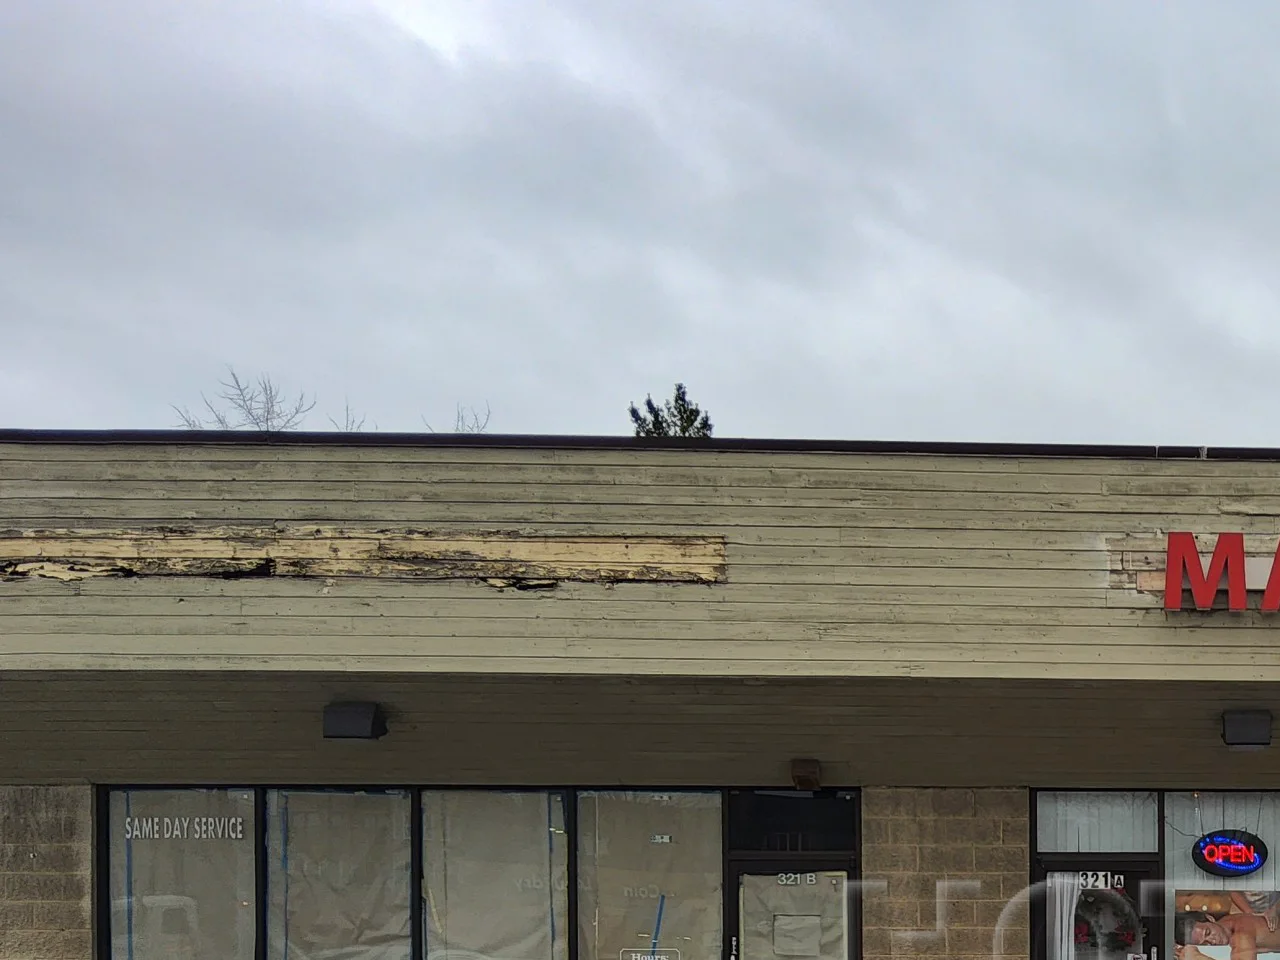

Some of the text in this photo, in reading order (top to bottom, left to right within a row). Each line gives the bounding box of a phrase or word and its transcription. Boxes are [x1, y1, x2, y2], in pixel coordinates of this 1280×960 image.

[125, 817, 243, 839] SAME DAY SERVICE
[1204, 844, 1255, 864] OPEN
[777, 873, 816, 885] 321 B
[1080, 872, 1123, 889] 321 A
